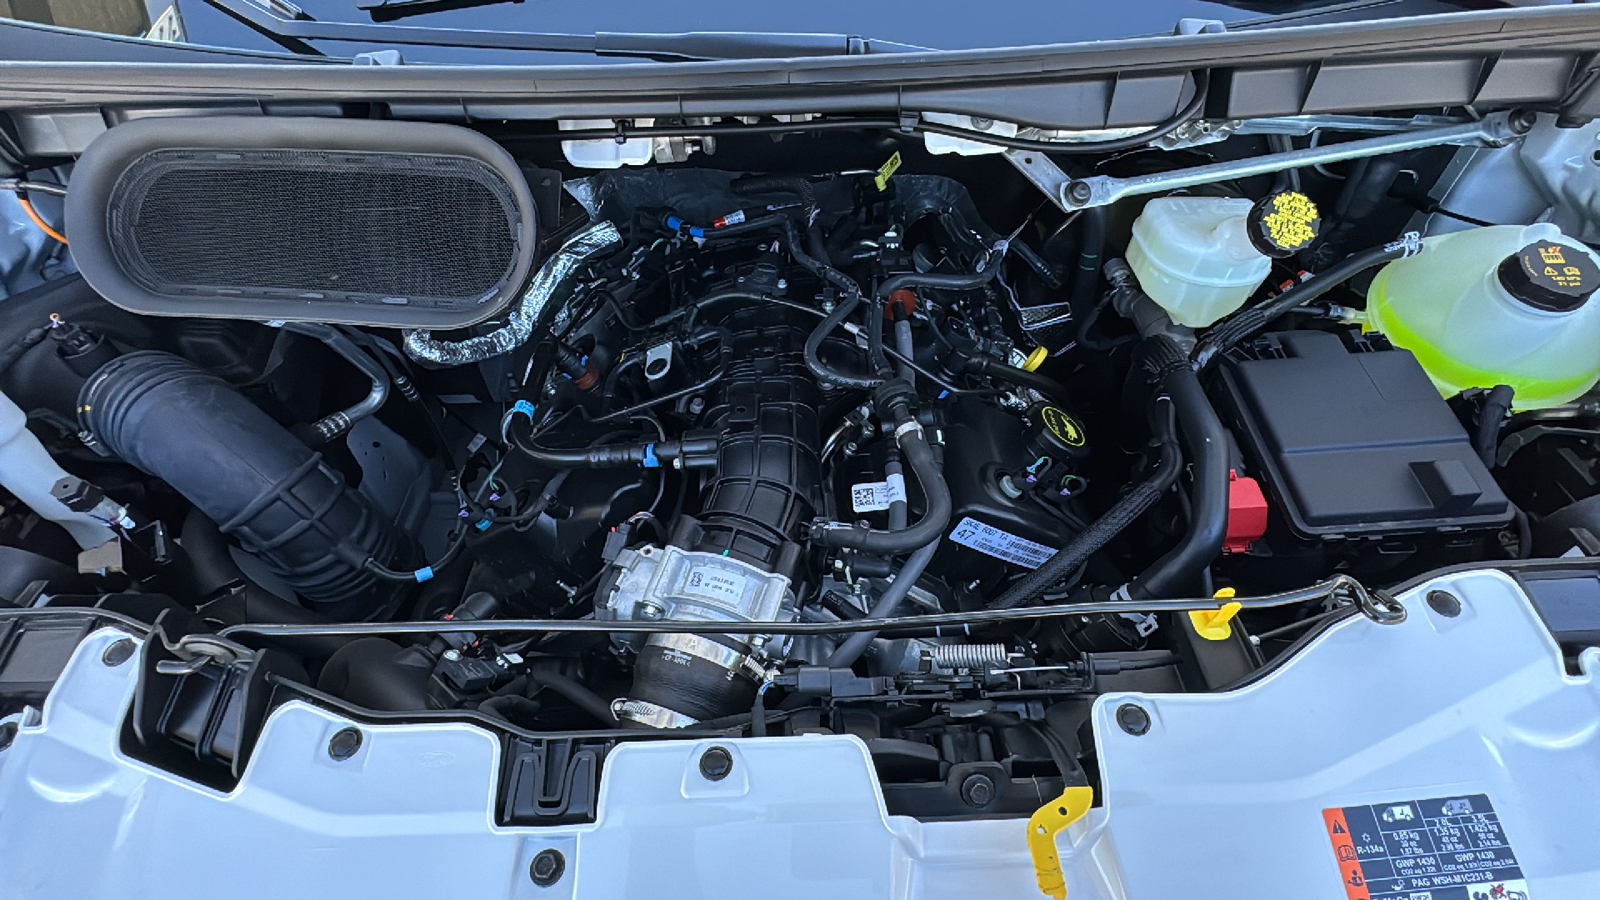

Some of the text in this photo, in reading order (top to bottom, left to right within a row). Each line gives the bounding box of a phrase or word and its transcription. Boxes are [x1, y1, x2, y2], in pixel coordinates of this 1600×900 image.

[957, 529, 976, 540] 47
[1392, 830, 1420, 840] 0.85 kg
[1434, 826, 1460, 837] 1.35 kg
[1356, 844, 1384, 854] R-134a
[1395, 856, 1435, 868] GWP 1430
[1455, 851, 1495, 862] GWP 1430
[1412, 872, 1494, 887] PAG WSH-M1C231-B
